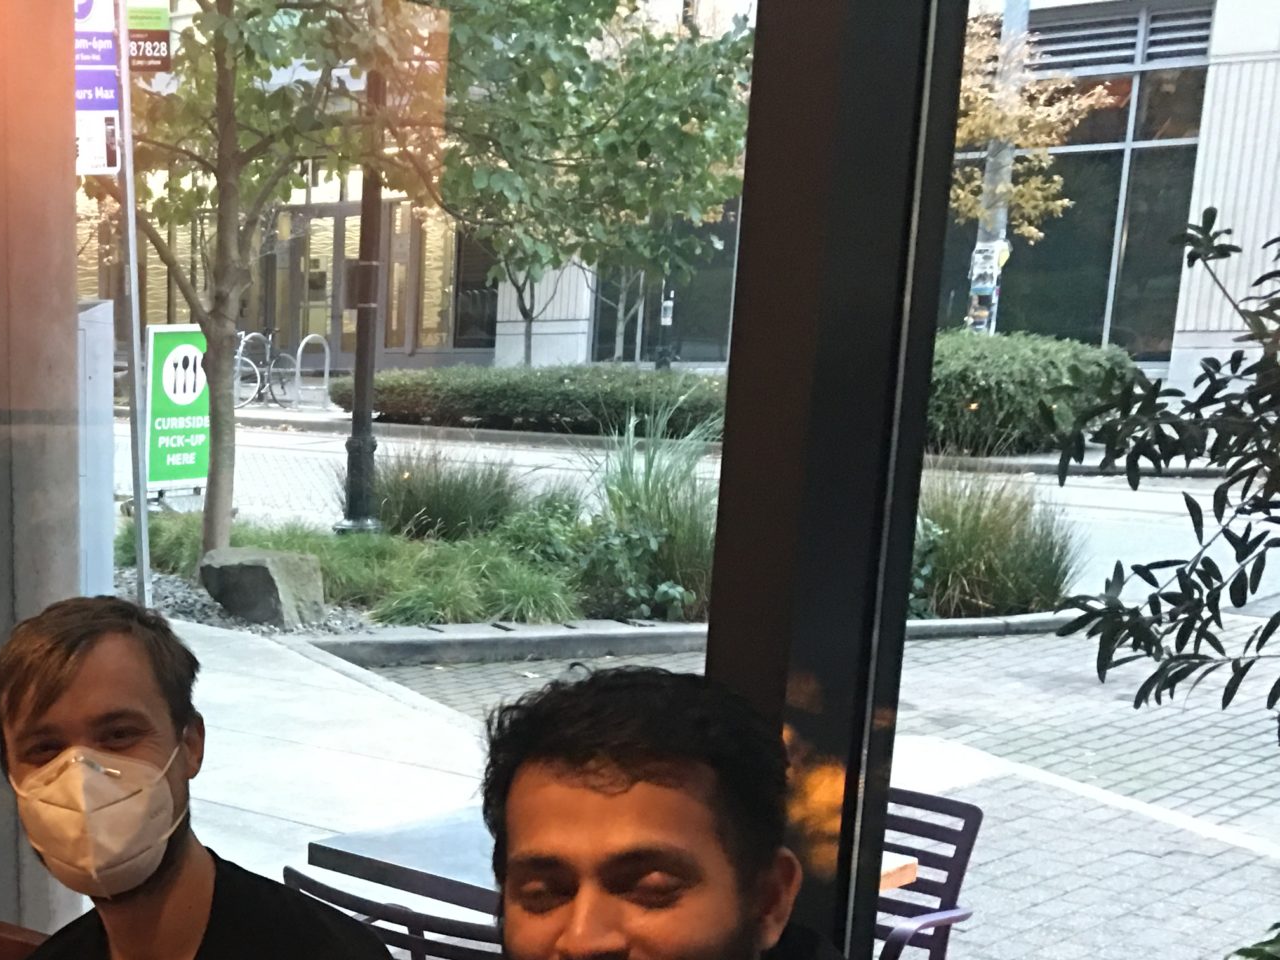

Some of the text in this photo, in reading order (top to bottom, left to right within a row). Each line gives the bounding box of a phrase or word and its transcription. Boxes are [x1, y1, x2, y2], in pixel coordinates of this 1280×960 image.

[129, 41, 168, 57] 87828
[95, 87, 115, 99] Max
[154, 416, 210, 430] CURBSIDE
[158, 434, 206, 448] PICK-UP
[166, 453, 195, 465] HERE
